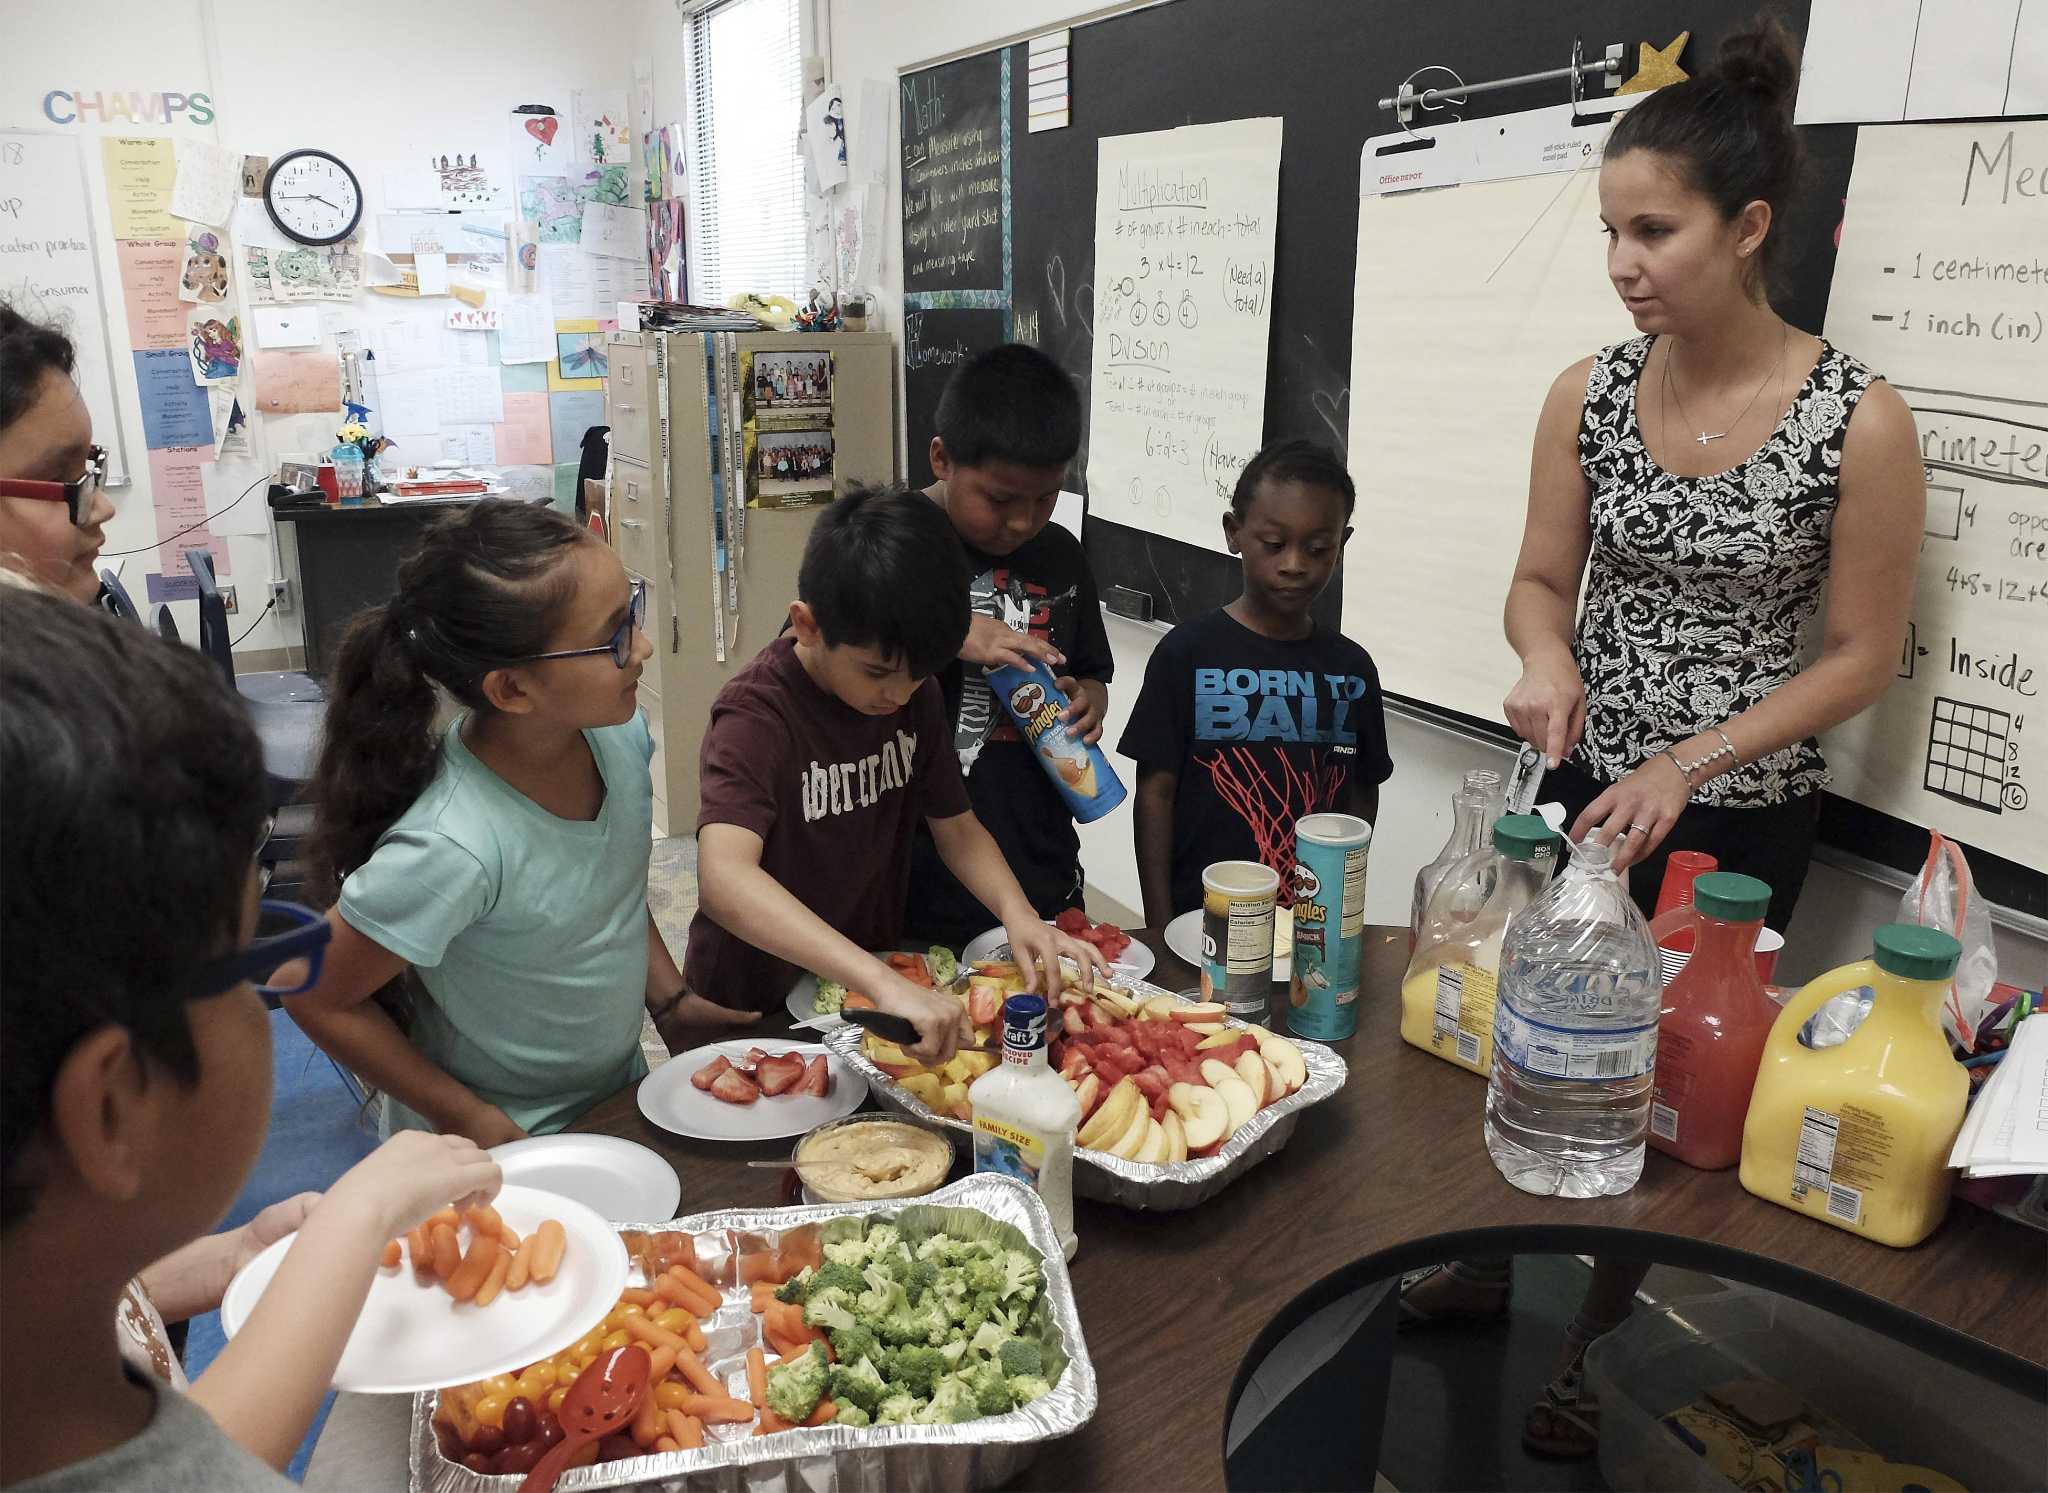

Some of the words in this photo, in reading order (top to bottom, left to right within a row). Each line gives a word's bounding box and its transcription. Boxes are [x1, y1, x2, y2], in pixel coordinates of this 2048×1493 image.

[43, 89, 216, 127] CHAMPS
[1928, 312, 1981, 338] inch
[1991, 310, 2044, 343] (in)
[1921, 426, 2048, 475] rimete
[1950, 637, 2039, 697] Inside
[1194, 668, 1315, 698] BORN
[1323, 672, 1367, 701] TO
[1024, 703, 1063, 744] Pringles
[1194, 694, 1357, 744] BALL
[2014, 714, 2024, 733] 4
[2007, 742, 2020, 762] 8
[2005, 764, 2021, 780] 12
[2004, 784, 2022, 804] 16
[1534, 844, 1551, 853] NON
[1294, 902, 1327, 926] ngles
[978, 1119, 1008, 1137] FAMILY
[1009, 1131, 1032, 1146] SIZE
